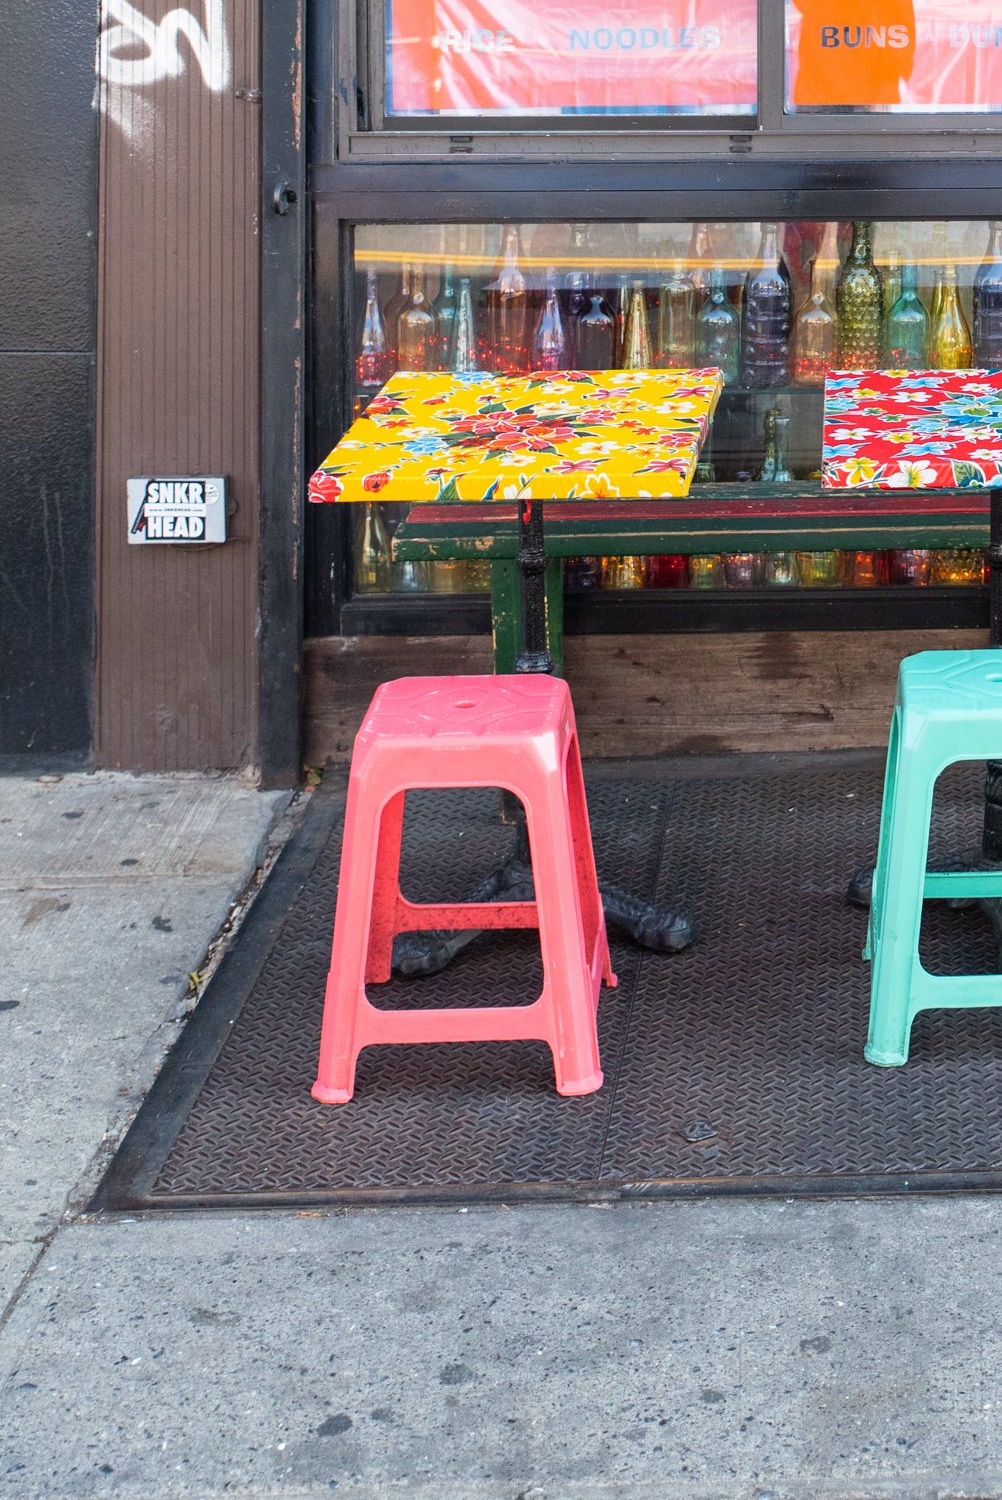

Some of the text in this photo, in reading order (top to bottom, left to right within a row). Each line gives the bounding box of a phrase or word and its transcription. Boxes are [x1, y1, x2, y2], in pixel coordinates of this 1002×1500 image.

[438, 26, 721, 52] RICE NOODLES
[820, 25, 910, 48] BUNS
[147, 482, 204, 503] SNKR
[147, 516, 204, 538] HEAD
